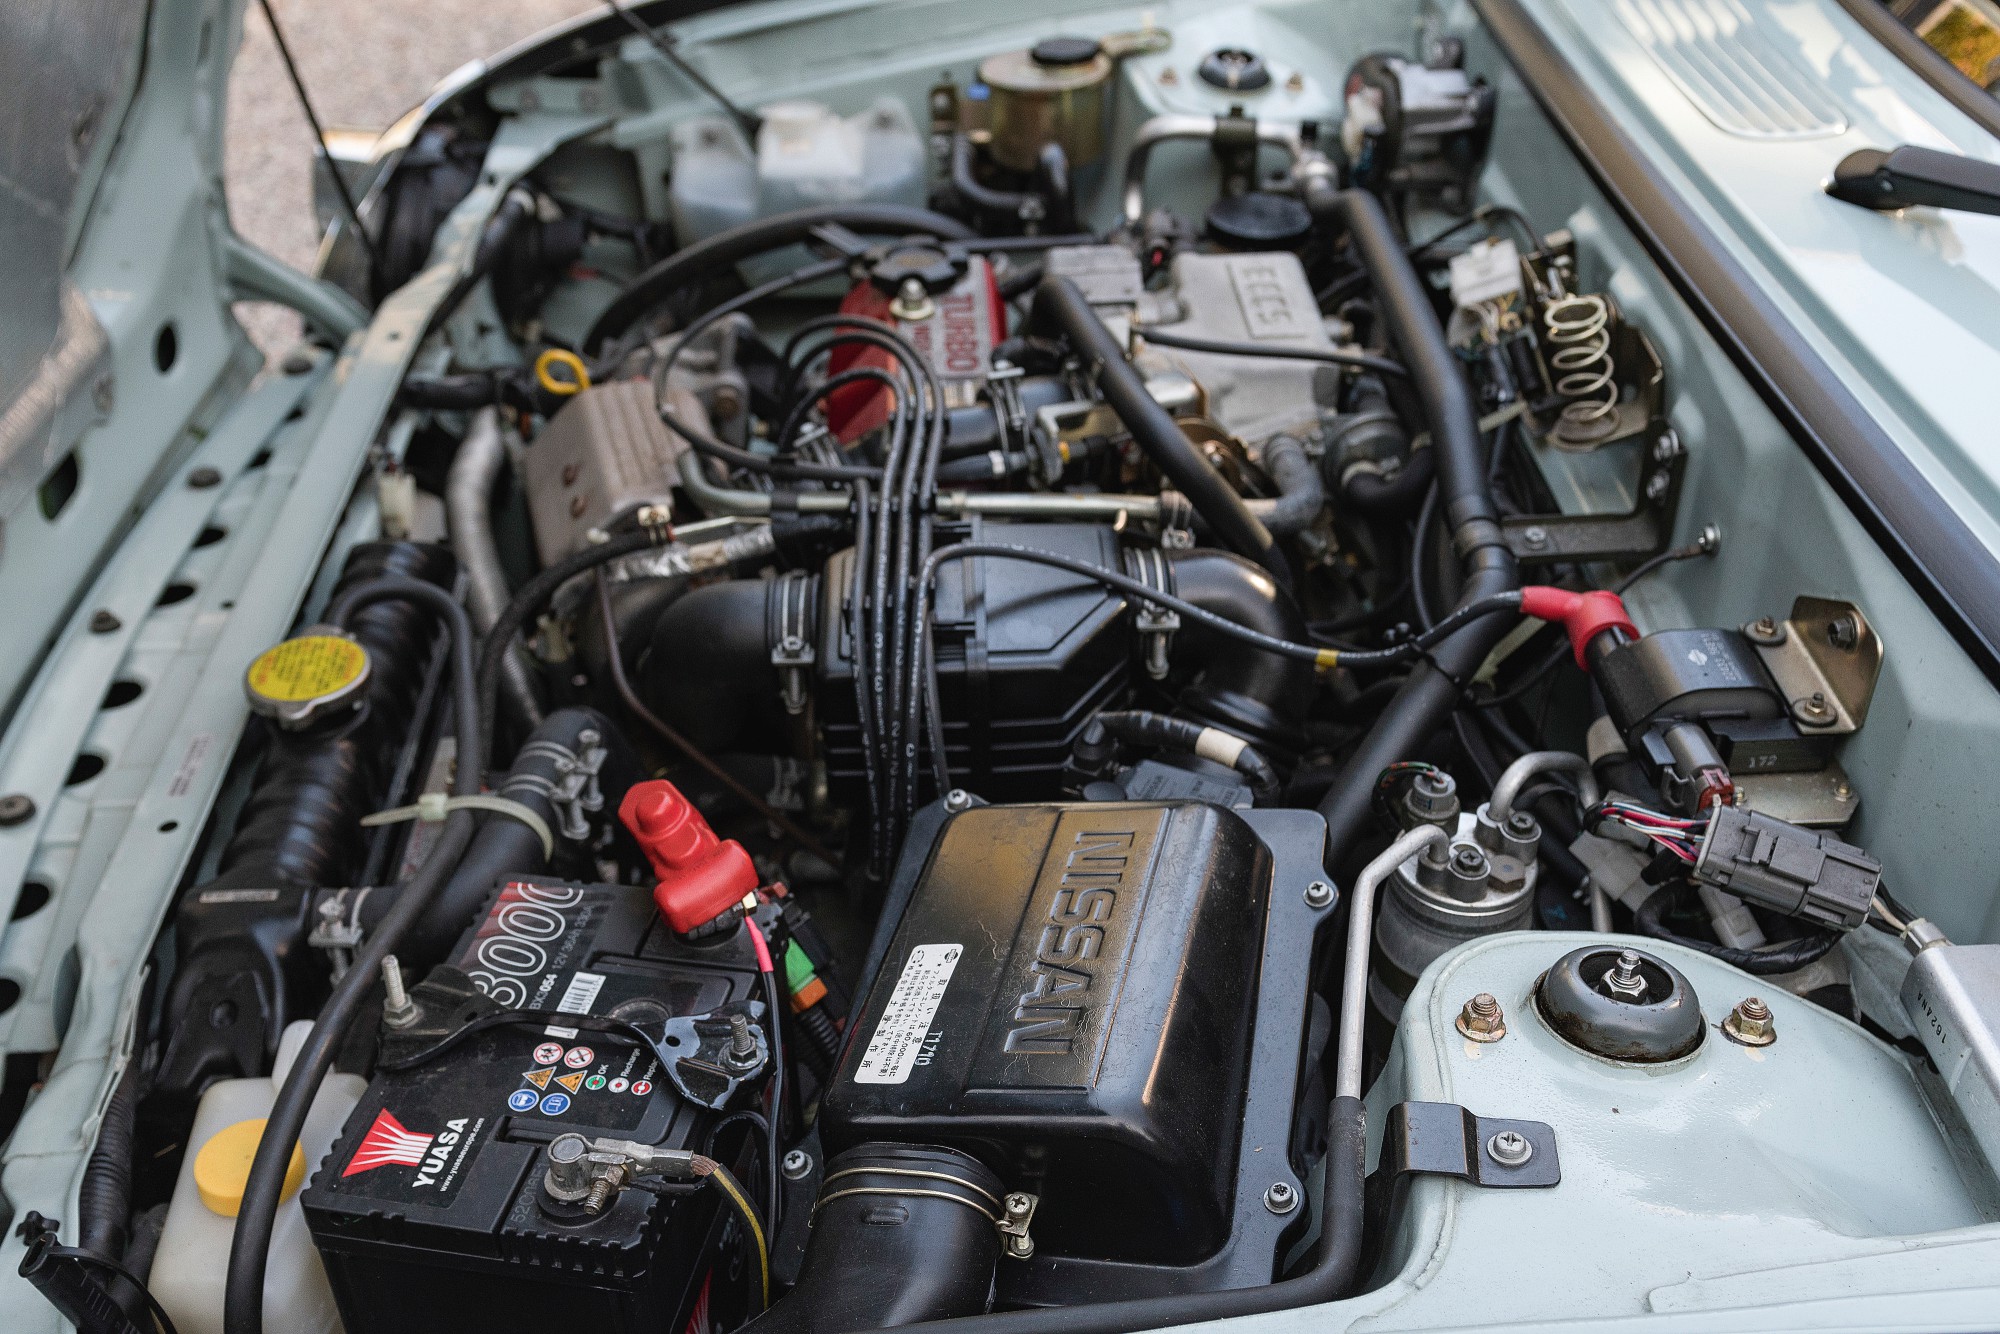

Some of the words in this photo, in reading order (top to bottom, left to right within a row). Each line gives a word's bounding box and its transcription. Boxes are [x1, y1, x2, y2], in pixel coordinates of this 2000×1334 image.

[942, 293, 978, 371] TURBO
[1004, 831, 1135, 1054] NISSAN
[598, 1064, 610, 1075] OK
[620, 1047, 641, 1078] Recharge
[412, 1118, 469, 1187] YUASA
[440, 1118, 485, 1191] www.yuasaeurope.com
